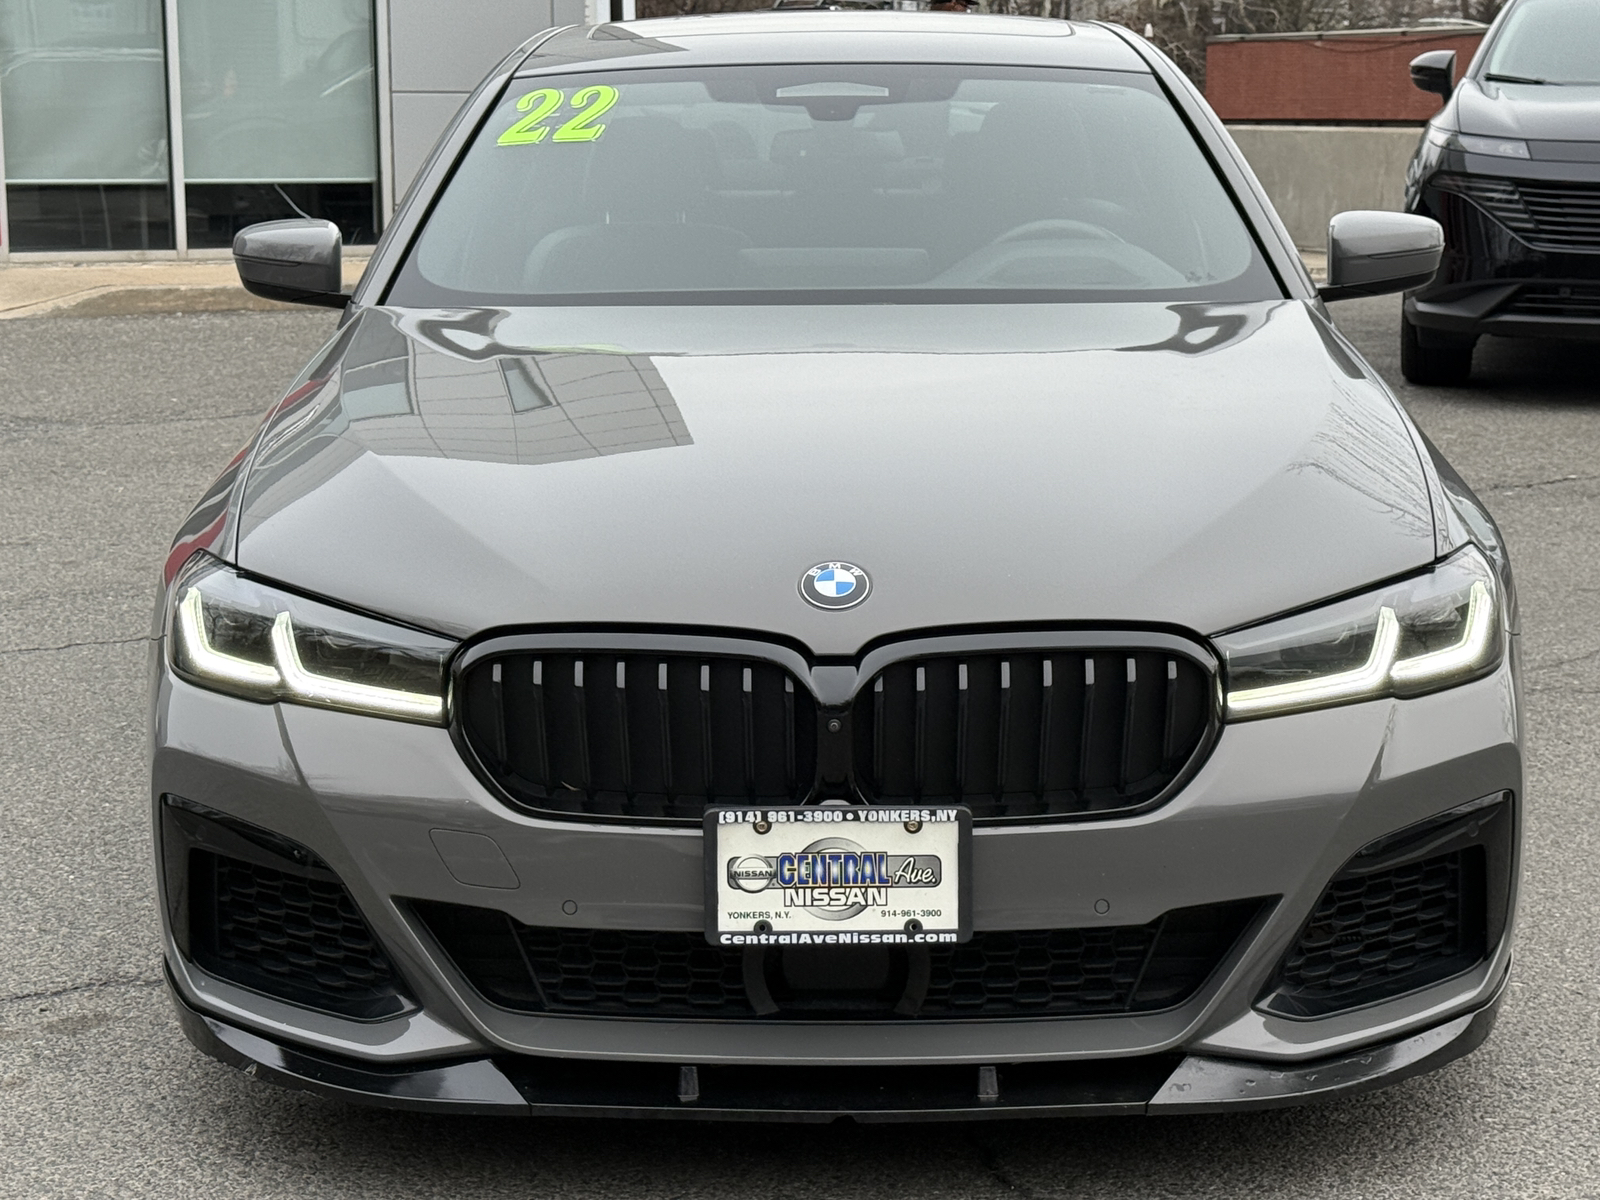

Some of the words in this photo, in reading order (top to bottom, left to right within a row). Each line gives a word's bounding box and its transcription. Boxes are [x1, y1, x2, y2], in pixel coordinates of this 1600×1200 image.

[496, 85, 619, 146] 22
[808, 562, 863, 576] BMW
[718, 810, 762, 823] (914)
[767, 810, 843, 822] 961-3900
[858, 809, 958, 822] YONKERS,NY
[733, 870, 773, 878] NISSAN
[778, 852, 892, 887] CENTRAL
[894, 856, 936, 884] Ave.
[784, 887, 888, 907] NISSAN
[727, 911, 773, 920] YONKERS,
[774, 911, 792, 919] N.Y.
[880, 909, 942, 918] 914-961-3900
[720, 932, 958, 945] CentralAveNissan.com
